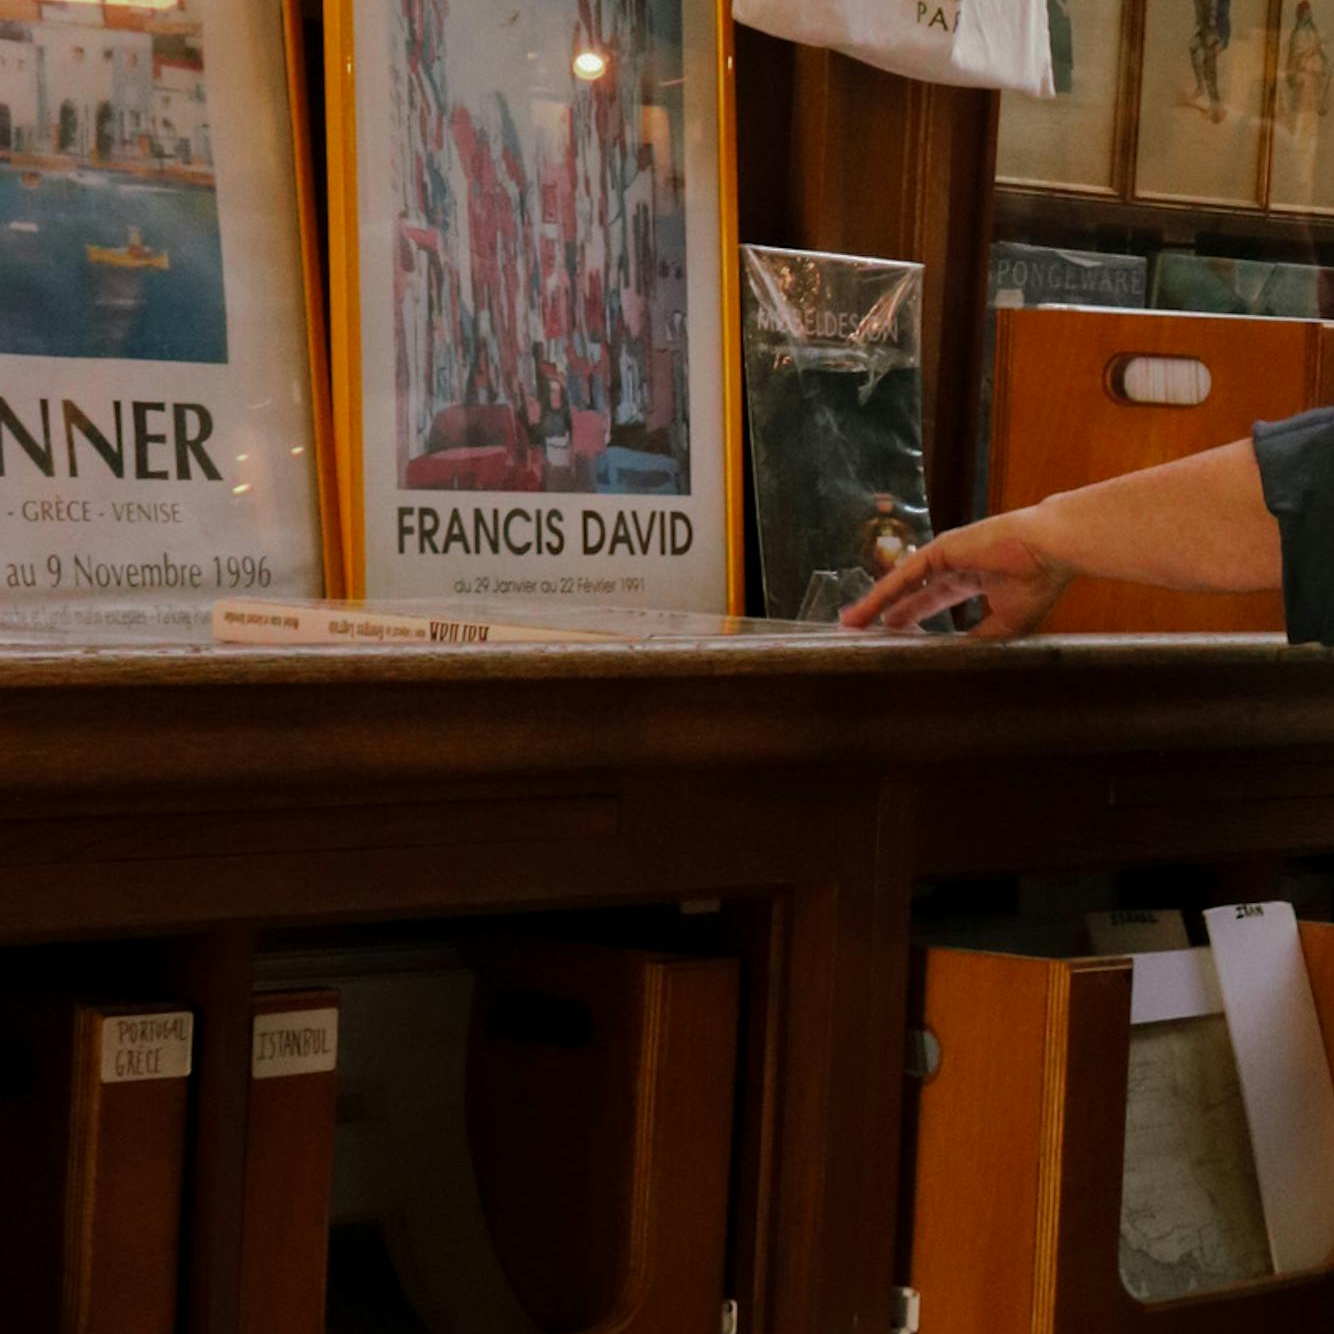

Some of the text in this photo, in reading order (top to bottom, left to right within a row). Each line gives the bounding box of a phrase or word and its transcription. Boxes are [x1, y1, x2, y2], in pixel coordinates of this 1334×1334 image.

[22, 495, 182, 524] GRÈCE VENISE
[397, 506, 695, 557] FRANCIS DAVID
[6, 552, 272, 589] au 9 Novembre 1996
[454, 576, 473, 595] du
[474, 576, 490, 595] 29
[492, 576, 538, 595] Janvier
[540, 579, 558, 595] au
[560, 576, 575, 595] 22
[621, 576, 645, 593] 1991
[115, 1017, 189, 1044] PORTUGAL
[256, 1027, 331, 1061] ISTANBUL
